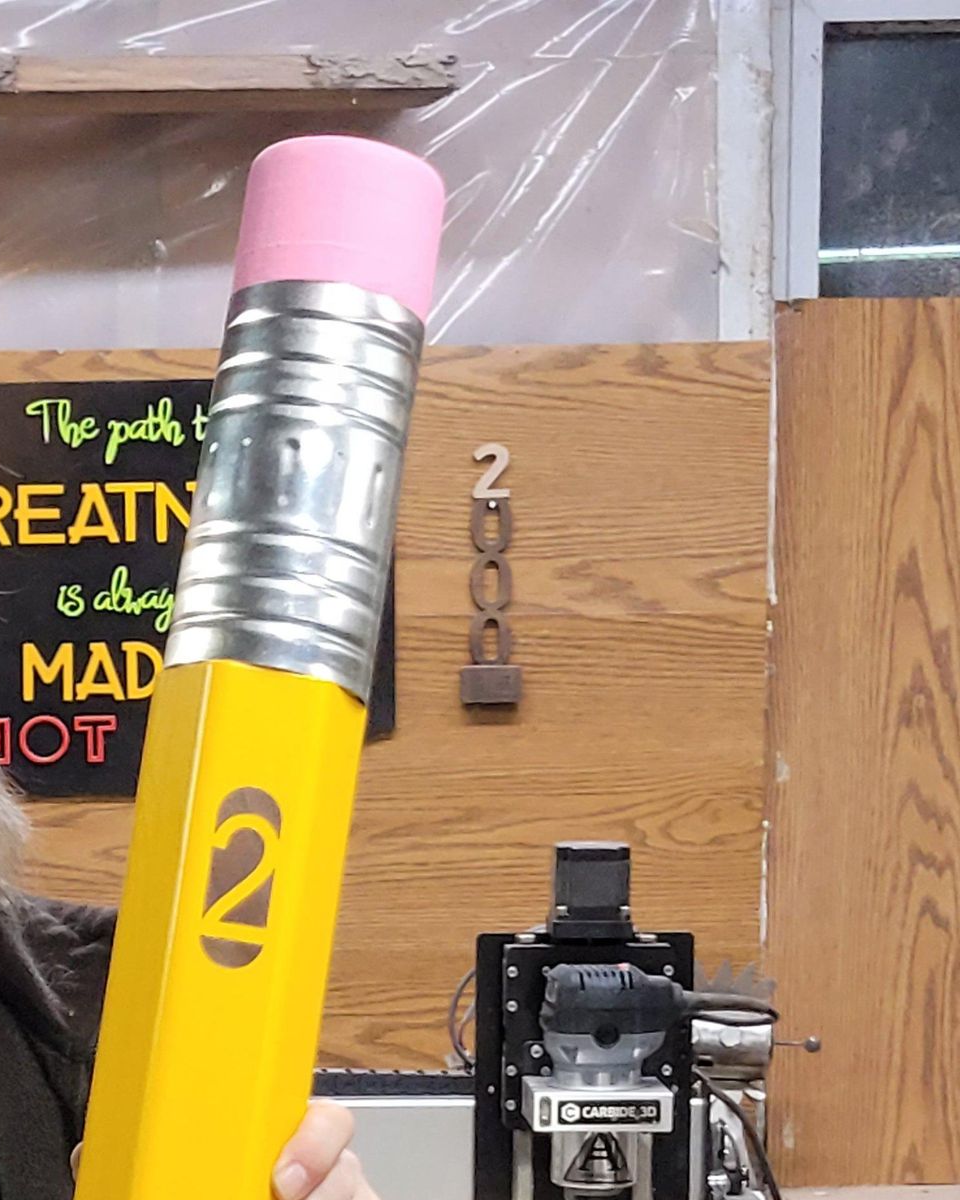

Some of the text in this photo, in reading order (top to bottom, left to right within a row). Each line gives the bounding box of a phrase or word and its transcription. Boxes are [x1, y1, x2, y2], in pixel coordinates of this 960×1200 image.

[26, 397, 210, 464] The path t
[93, 565, 175, 633] alway
[21, 641, 164, 702] MAD
[199, 812, 281, 946] 2
[582, 1105, 637, 1119] CARBIDE
[640, 1105, 657, 1118] 3D
